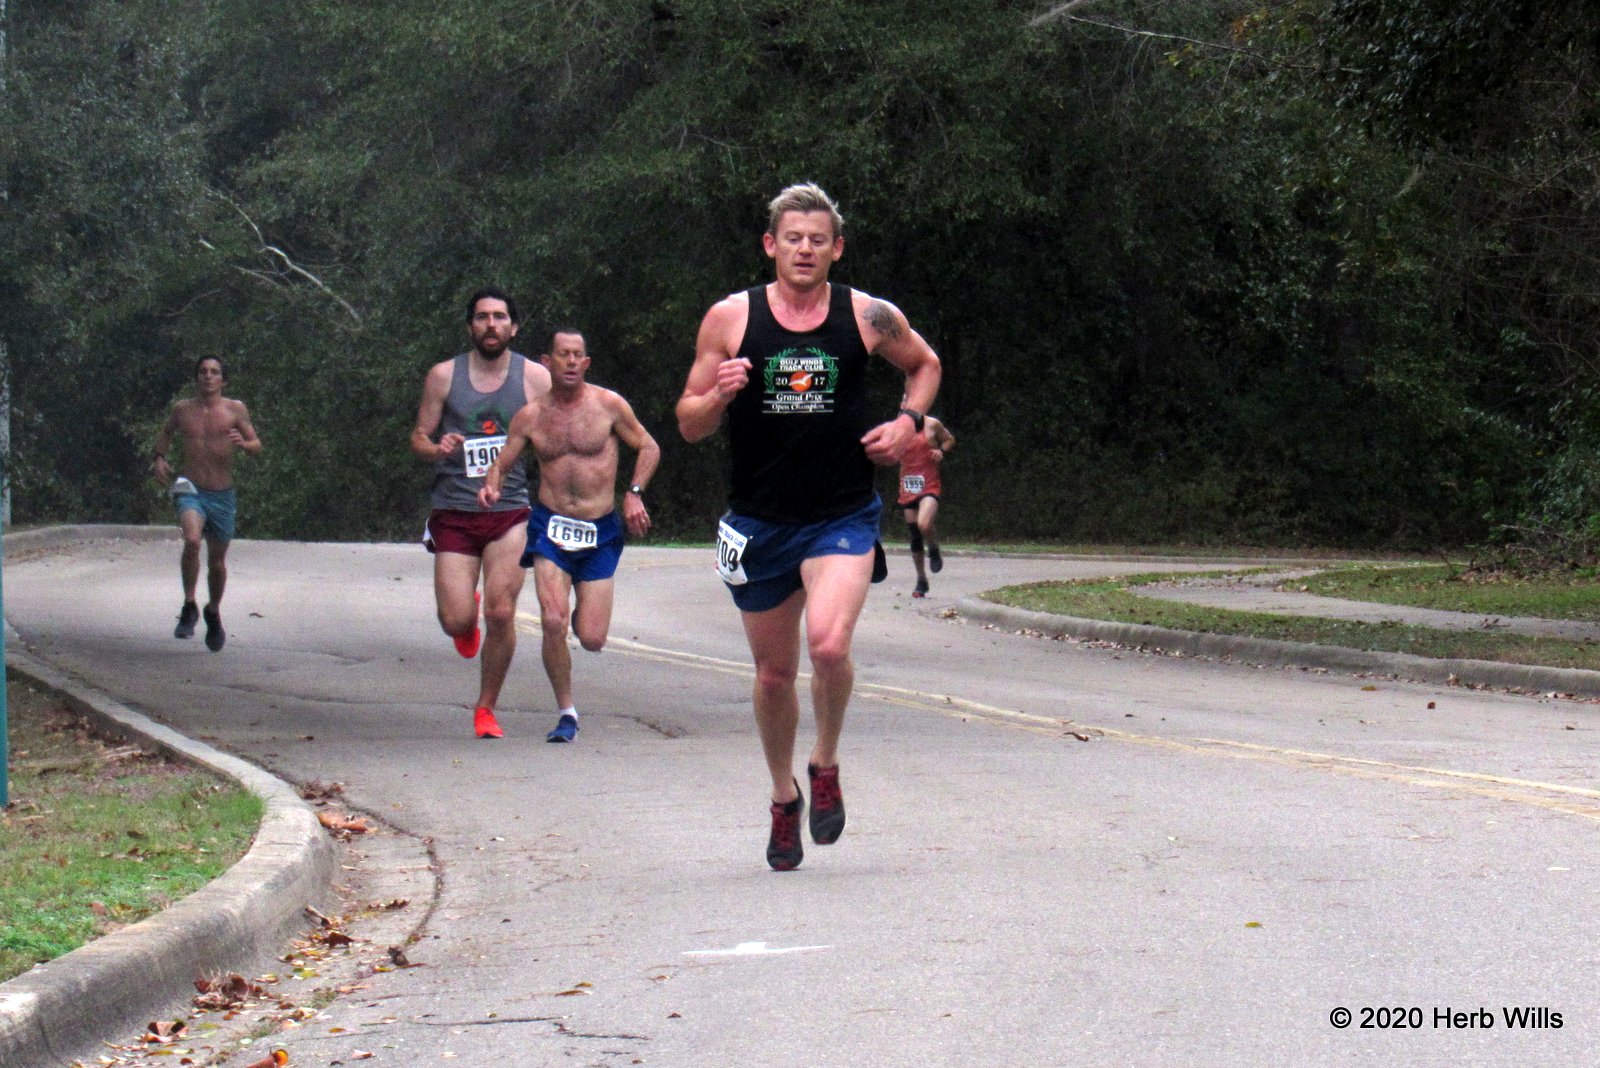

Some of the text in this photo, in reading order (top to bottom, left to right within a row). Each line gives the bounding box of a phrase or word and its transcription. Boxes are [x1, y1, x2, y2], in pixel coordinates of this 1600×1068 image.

[775, 377, 826, 385] 20 17
[776, 393, 802, 401] Grand
[771, 404, 790, 412] Open
[467, 445, 505, 467] 190
[551, 524, 596, 544] 1690
